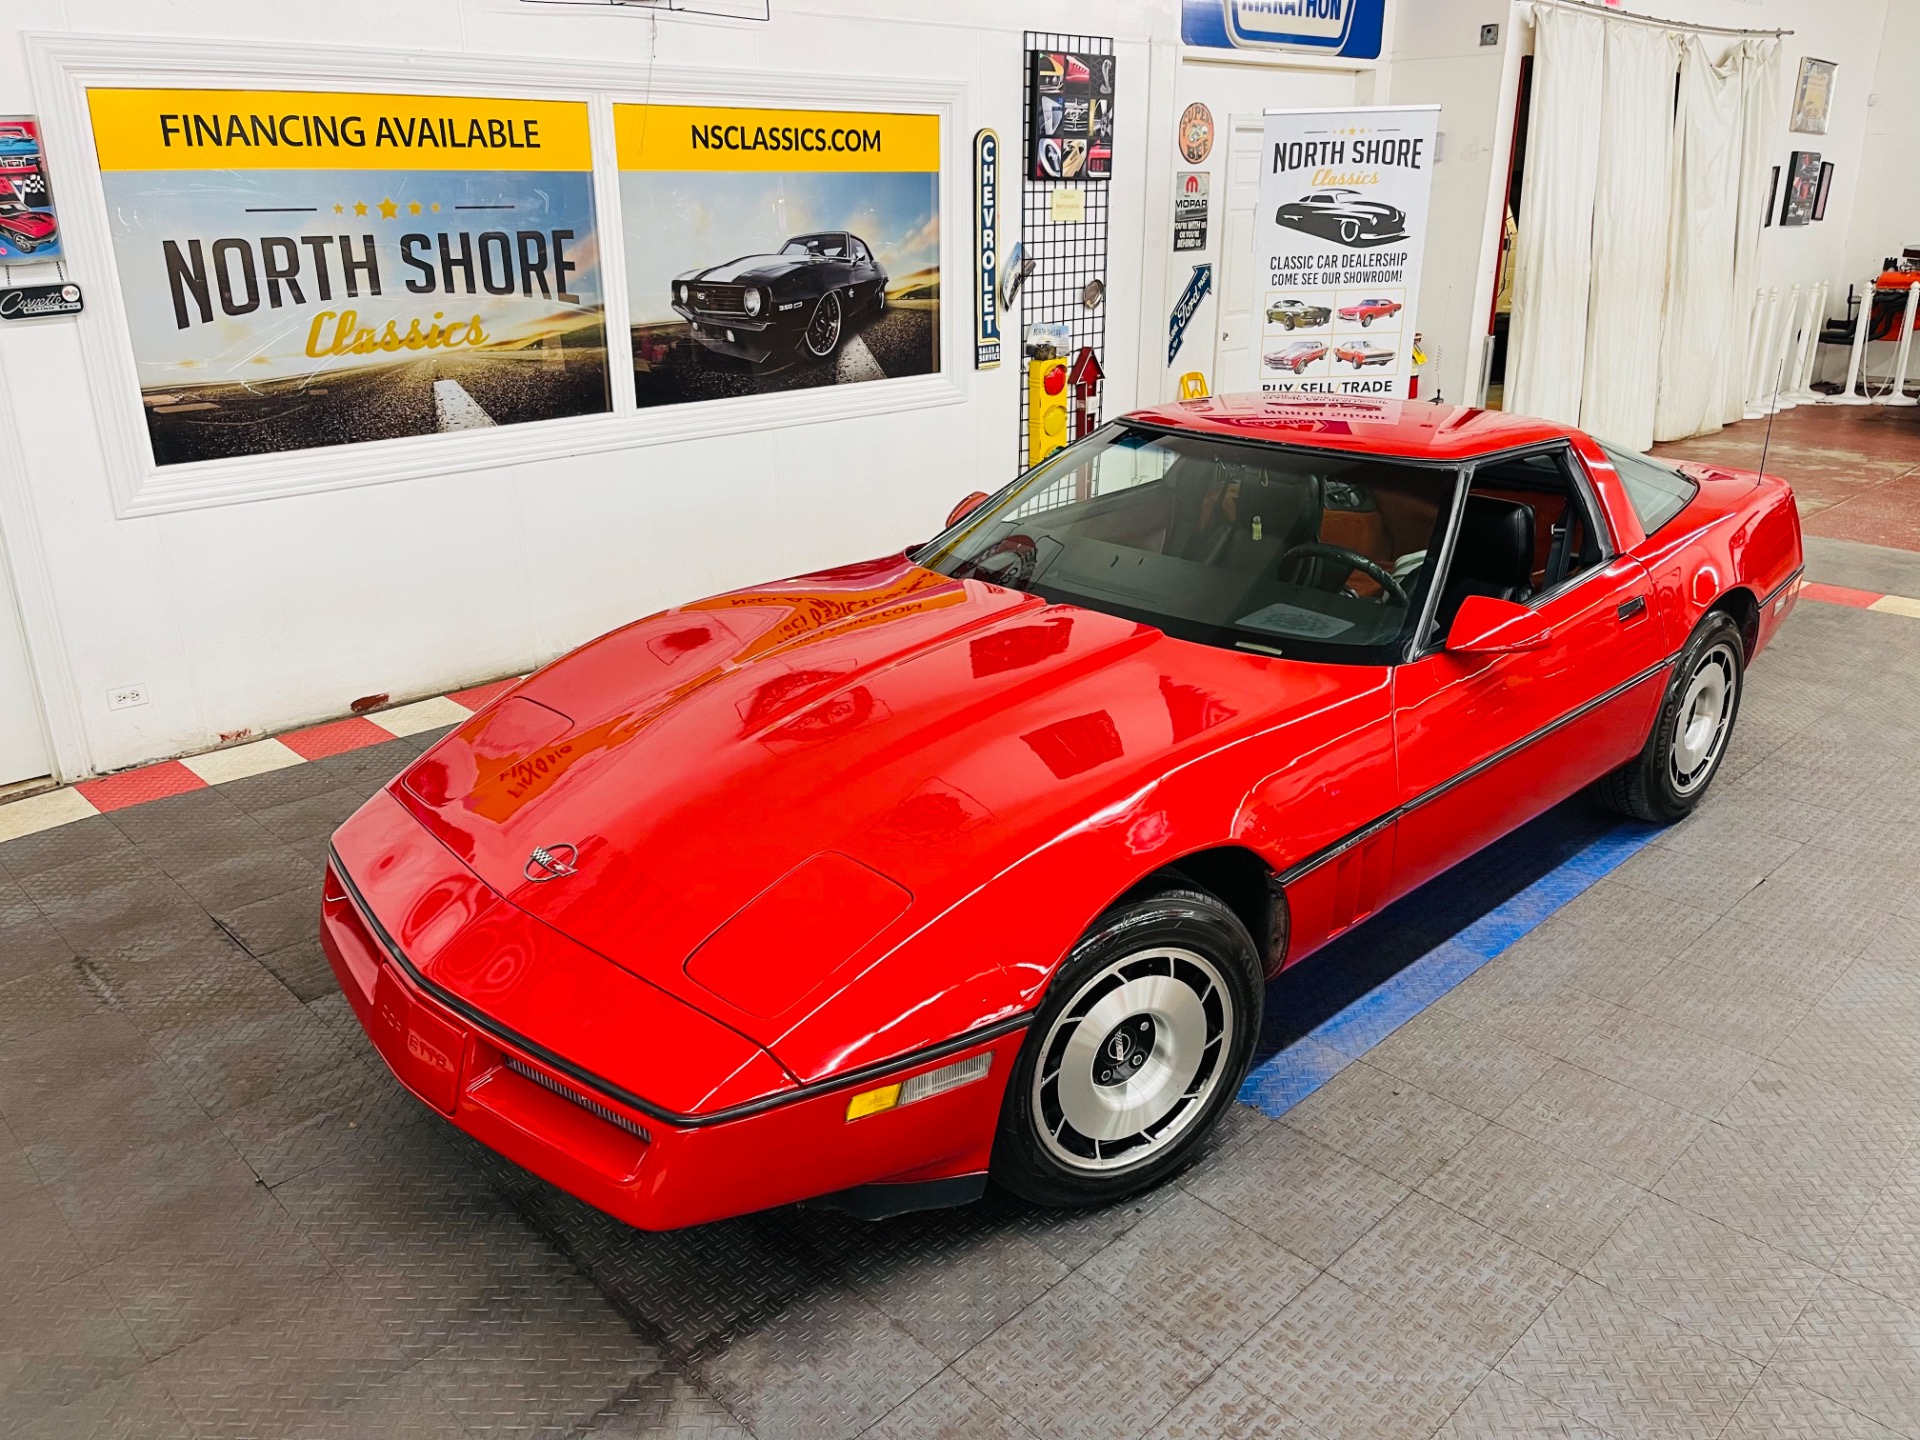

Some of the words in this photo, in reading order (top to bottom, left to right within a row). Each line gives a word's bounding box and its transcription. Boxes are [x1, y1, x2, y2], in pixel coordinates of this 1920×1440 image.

[160, 114, 366, 147] FINANCING
[375, 116, 541, 148] AVAILABLE
[691, 124, 881, 152] NSCLASSICS.COM
[1186, 138, 1209, 160] BEE
[1273, 141, 1345, 174] NORTH
[1352, 139, 1423, 169] SHORE
[1311, 169, 1380, 187] Classics
[1176, 200, 1208, 208] MOPAR
[982, 141, 995, 334] CHEVROLET
[1270, 255, 1313, 270] CLASSIC
[1317, 255, 1338, 269] CAR
[1342, 252, 1407, 268] DEALERSHIP
[162, 234, 382, 330] NORTH
[402, 229, 580, 305] SHORE
[1271, 273, 1299, 286] COME
[1302, 272, 1319, 285] SEE
[1322, 272, 1341, 284] OUR
[1344, 270, 1402, 283] SHOWROOM!
[0, 291, 65, 315] Corvette
[1178, 285, 1201, 327] Ford
[304, 310, 489, 359] Classics
[1656, 704, 1676, 769] KUMHO
